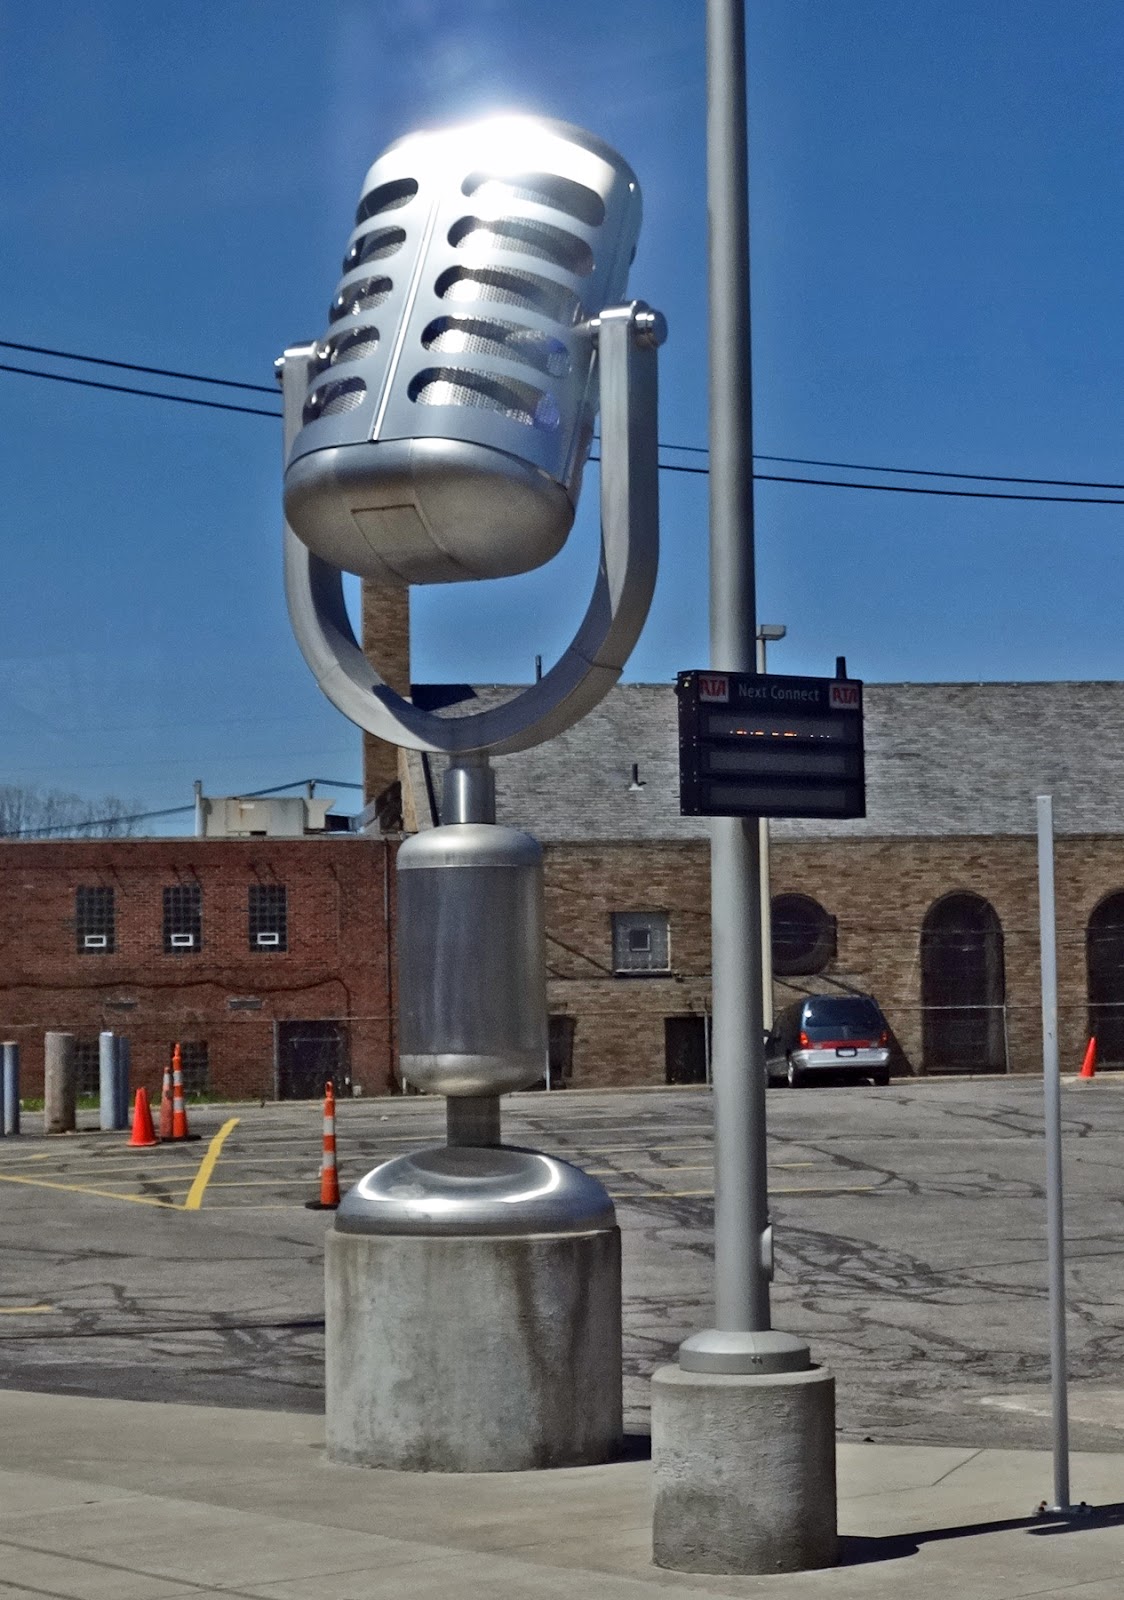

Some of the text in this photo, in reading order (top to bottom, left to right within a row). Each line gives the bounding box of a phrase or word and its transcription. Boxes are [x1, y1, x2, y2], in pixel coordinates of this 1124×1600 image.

[738, 683, 820, 701] Next Connect
[832, 687, 859, 704] RTA
